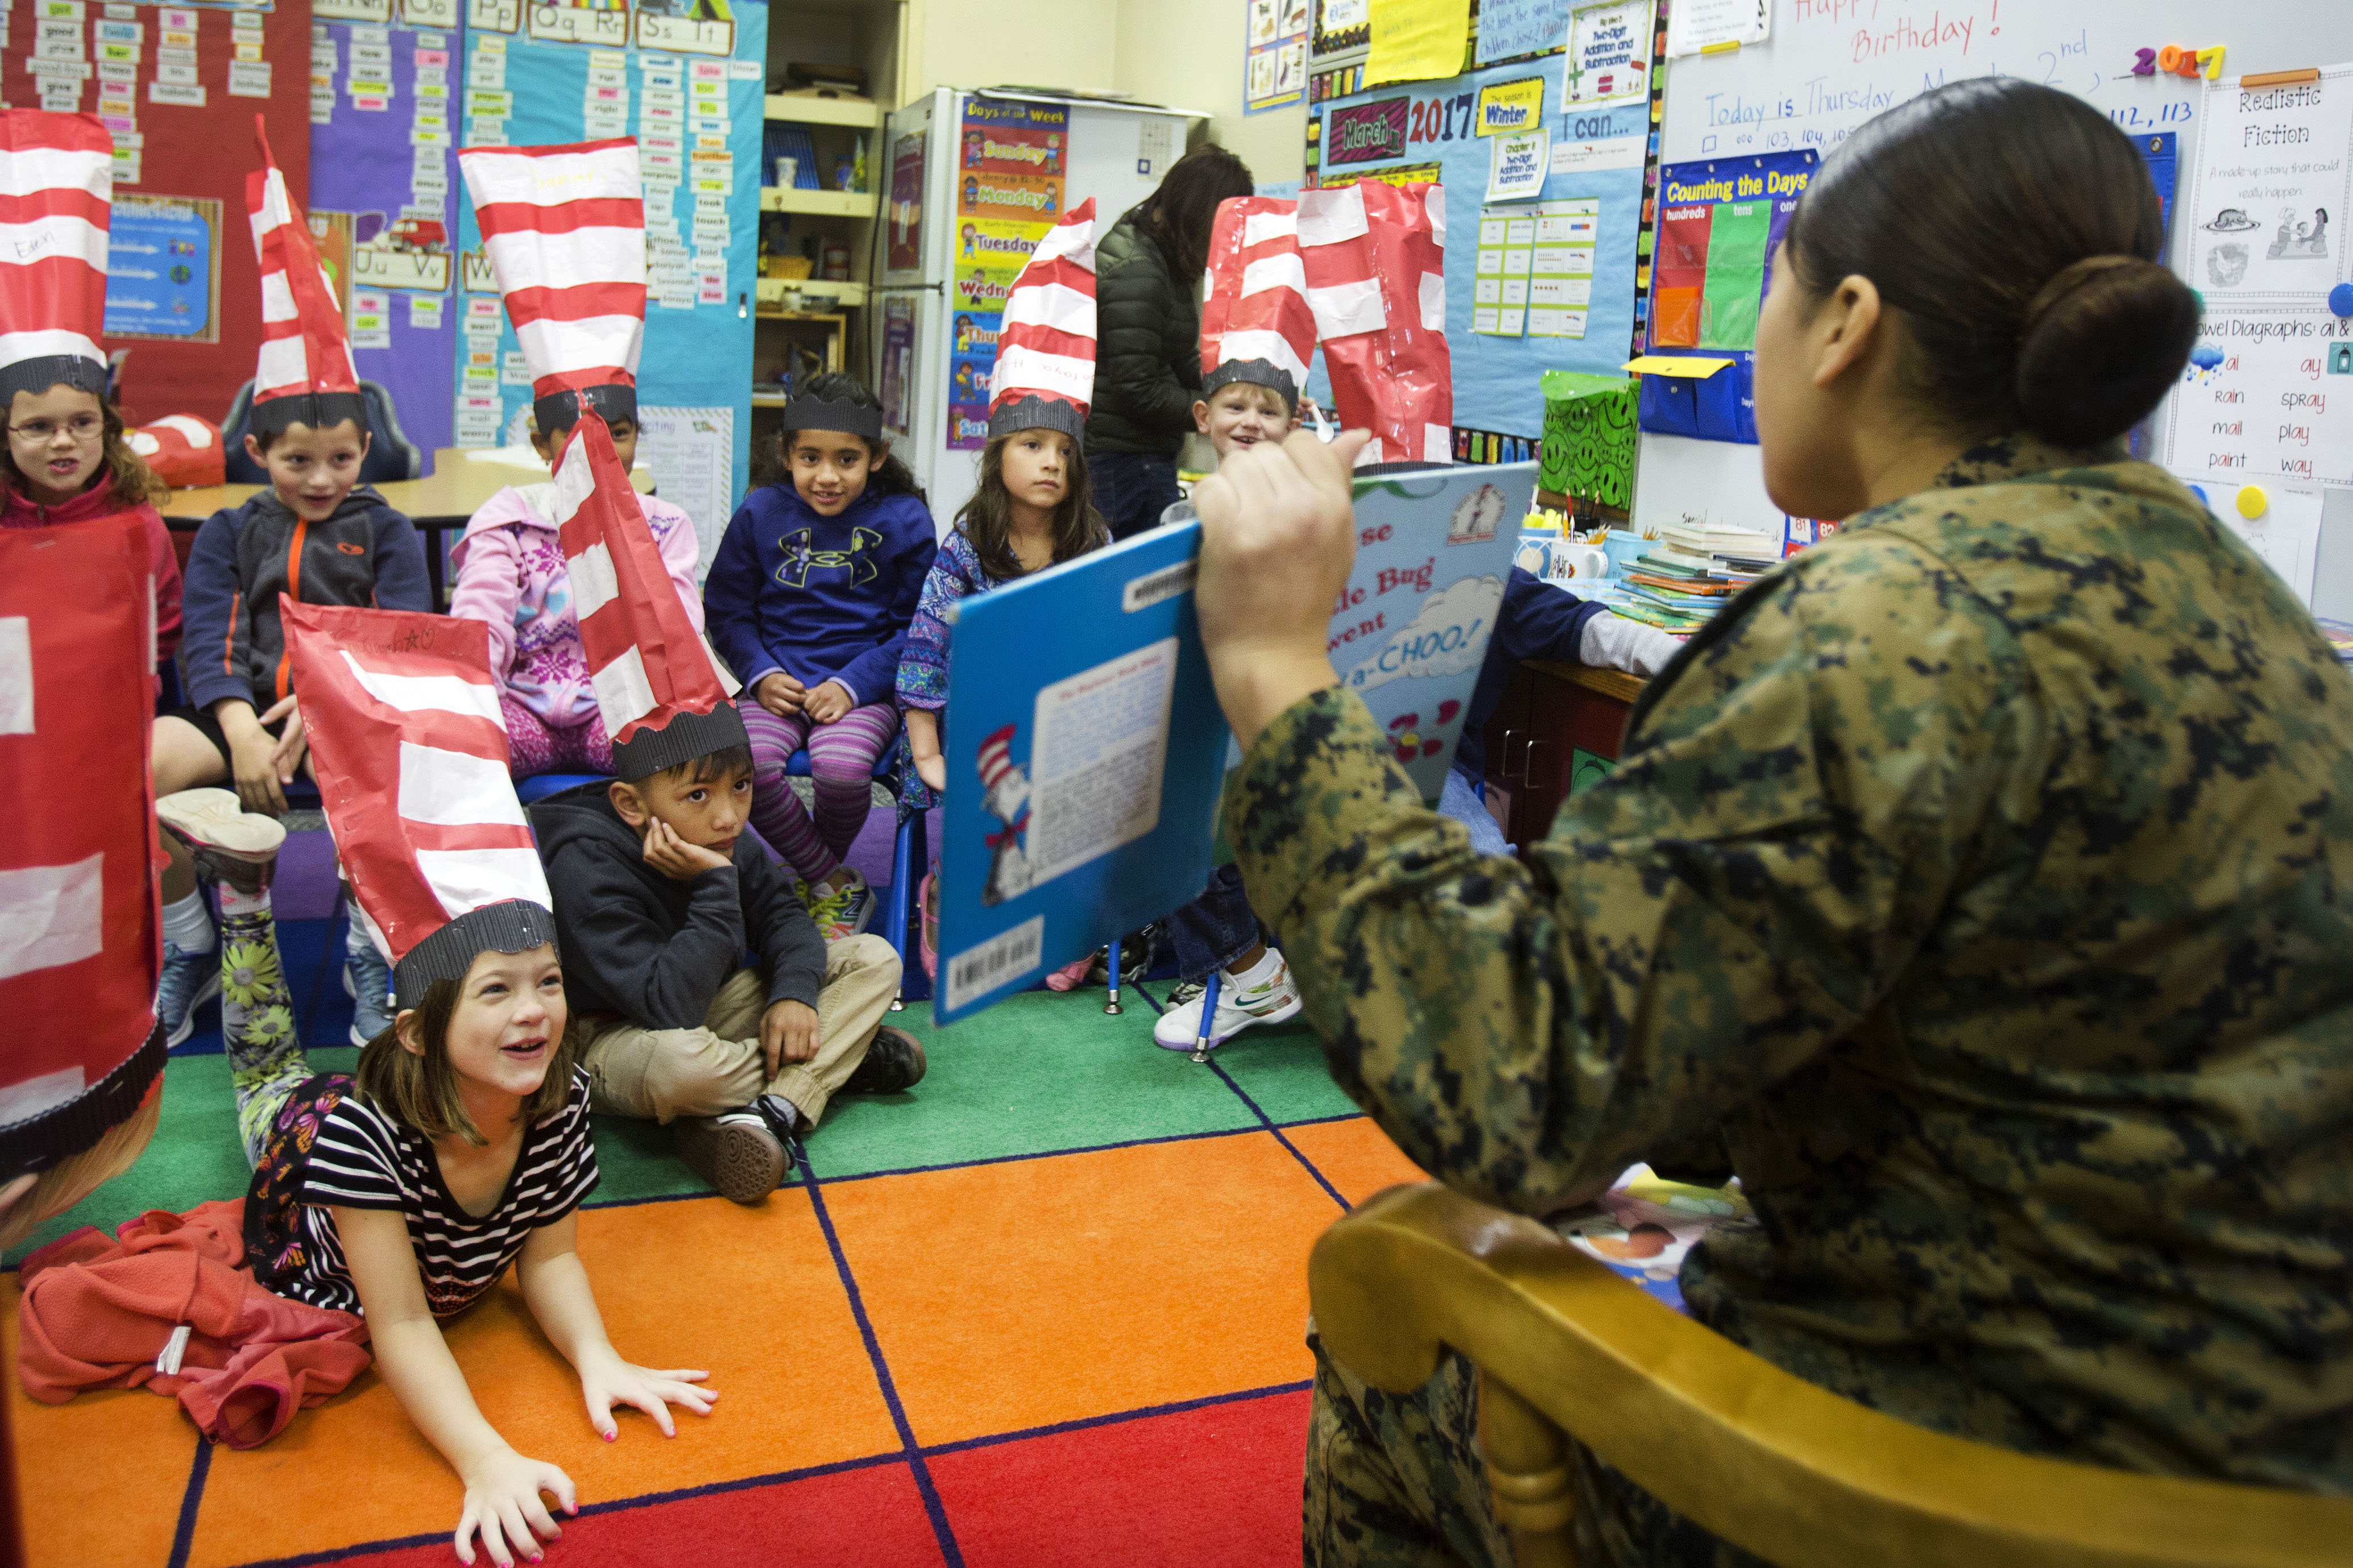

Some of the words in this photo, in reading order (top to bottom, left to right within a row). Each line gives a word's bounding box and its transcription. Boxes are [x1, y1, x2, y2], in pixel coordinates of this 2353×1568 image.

[1593, 26, 1627, 41] Two-Digit
[1584, 42, 1615, 56] Addition
[1618, 38, 1634, 52] and
[1585, 55, 1631, 70] Subtraction
[2131, 45, 2226, 80] 2017
[1504, 93, 1525, 102] season
[1526, 91, 1532, 99] is
[1705, 92, 1764, 131] Today
[1778, 92, 1793, 118] is
[1805, 75, 1895, 115] Thursday
[2239, 86, 2322, 114] Realistic
[967, 102, 999, 120] Days
[1013, 109, 1026, 119] the
[1029, 110, 1065, 125] Week
[1343, 113, 1389, 151] March
[1409, 93, 1474, 144] 2017
[1485, 105, 1528, 126] Winter
[2161, 102, 2193, 122] 113
[1564, 115, 1568, 141] I
[2243, 125, 2310, 148] Fiction
[983, 140, 1048, 167] Sunday
[1505, 143, 1530, 154] Chapter
[1506, 153, 1532, 165] Two-Digit
[641, 171, 678, 180] surprise
[1499, 165, 1524, 176] Addition
[1525, 163, 1538, 173] and
[1499, 173, 1534, 185] Subtraction
[2210, 167, 2217, 180] A
[2218, 164, 2261, 181] made-up
[2264, 163, 2289, 180] story
[2291, 162, 2311, 174] that
[2313, 159, 2339, 173] could
[1667, 178, 1734, 202] Counting
[1738, 173, 1763, 196] the
[1768, 171, 1808, 197] Days
[2239, 186, 2263, 201] really
[2265, 185, 2303, 201] happen
[977, 185, 1050, 211] Monday
[1666, 205, 1706, 221] hundreds
[1734, 204, 1753, 216] tens
[696, 217, 726, 226] touch
[958, 280, 1010, 297] Wedn
[2197, 320, 2228, 337] owel
[2339, 323, 2350, 337] &
[2226, 355, 2240, 371] ai
[2301, 358, 2322, 380] ay
[974, 374, 992, 391] Fr
[2213, 420, 2243, 436] mail
[2279, 424, 2310, 446] play
[2209, 452, 2247, 470] paint
[2281, 458, 2313, 479] way
[1796, 518, 1807, 531] 81
[1820, 524, 1835, 538] 82
[1375, 555, 1436, 597] Bug
[1340, 617, 1483, 686] a-CHOO!
